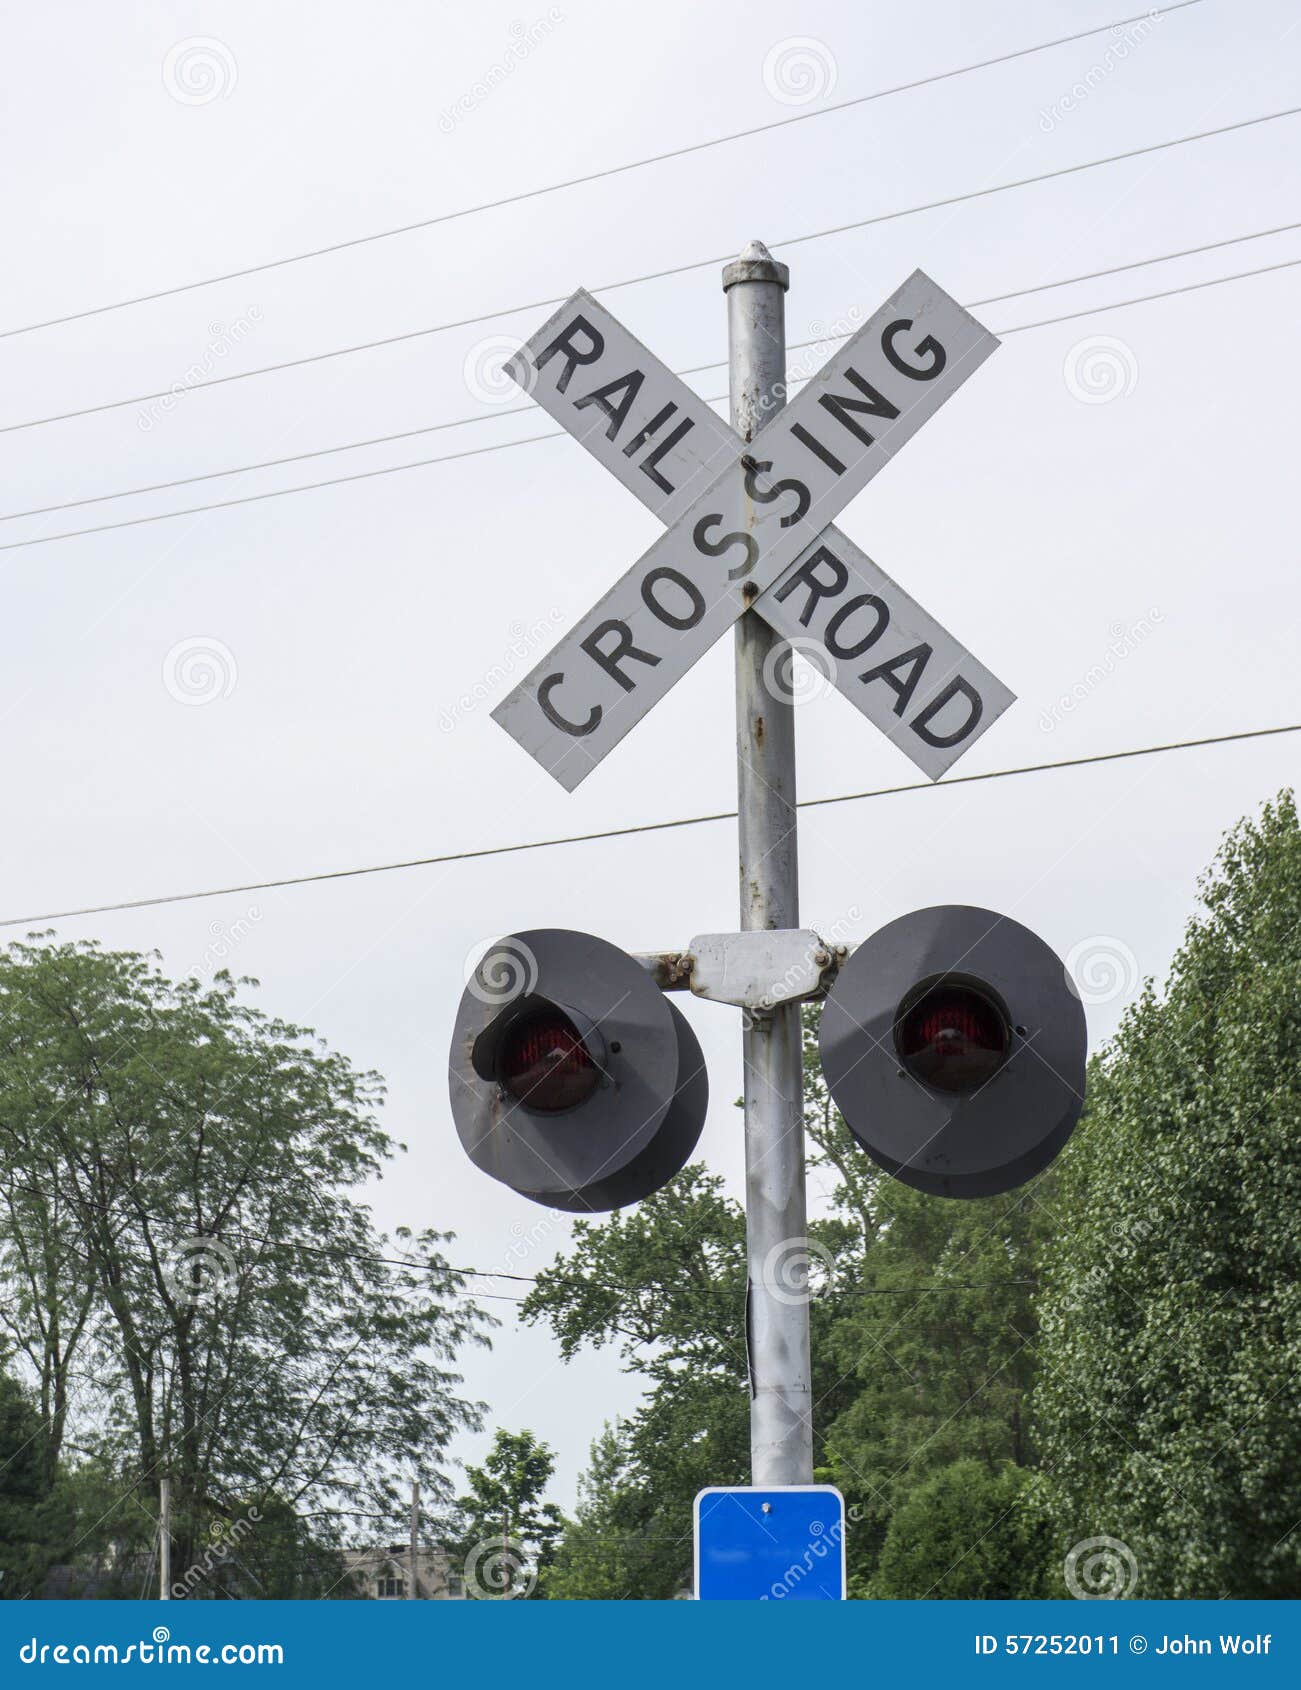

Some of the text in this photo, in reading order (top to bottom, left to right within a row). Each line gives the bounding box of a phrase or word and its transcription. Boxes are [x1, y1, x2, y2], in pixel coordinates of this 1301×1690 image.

[531, 314, 983, 749] RAIL ROAD
[537, 318, 947, 738] CROSSING
